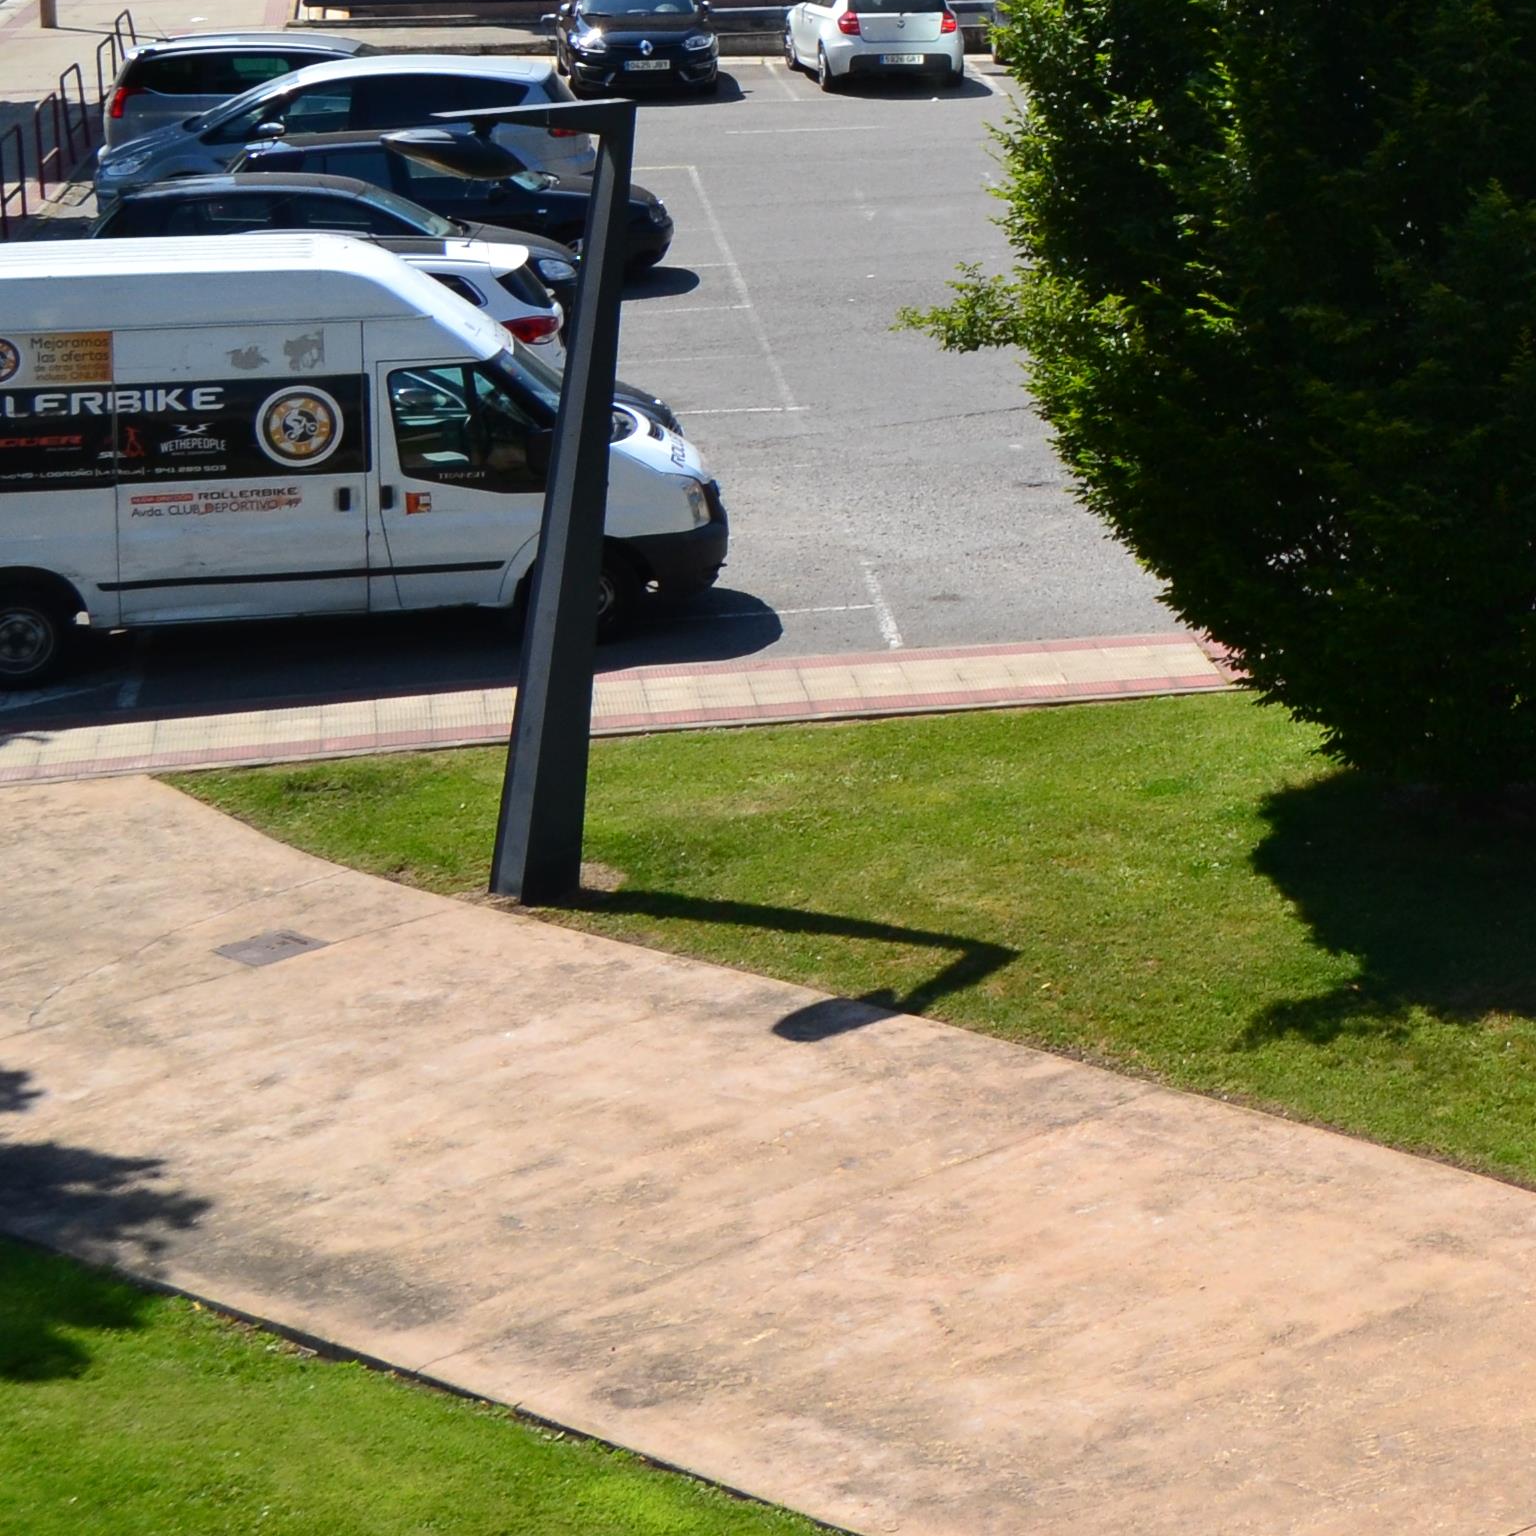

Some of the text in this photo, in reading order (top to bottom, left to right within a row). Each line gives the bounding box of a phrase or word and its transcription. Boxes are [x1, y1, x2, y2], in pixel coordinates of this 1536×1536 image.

[30, 337, 110, 351] Mejoramos
[37, 350, 110, 363] las ofertas
[159, 437, 227, 453] WETHEPEOPLE
[198, 486, 298, 501] ROLLERBIKE
[168, 503, 201, 516] CLUB
